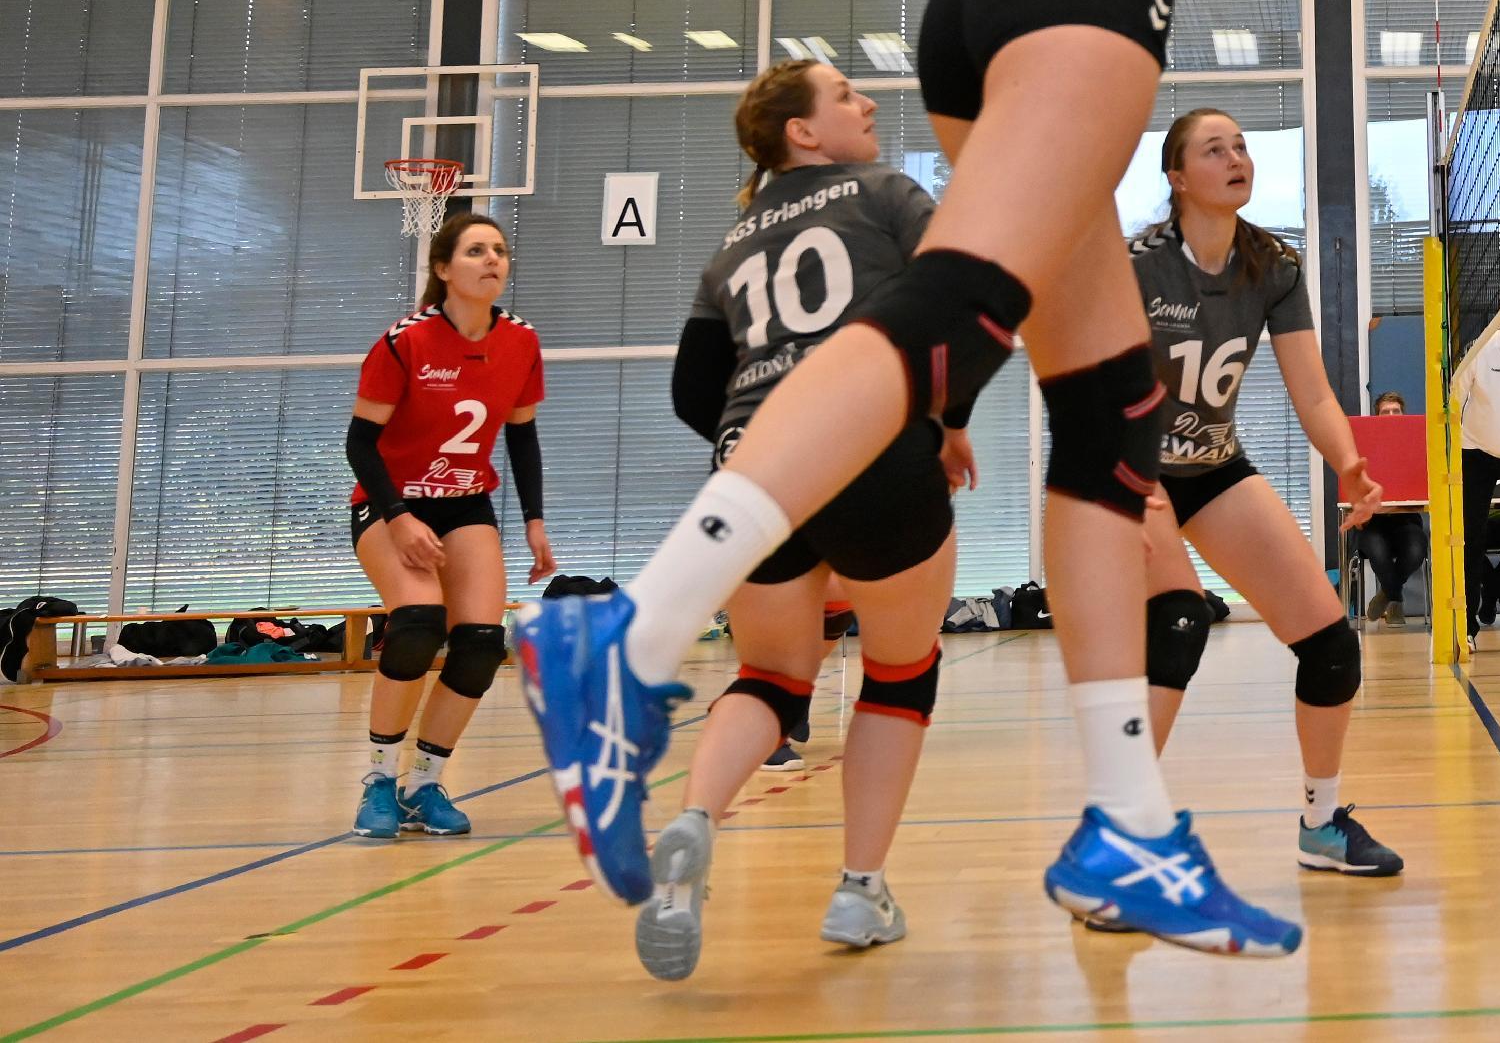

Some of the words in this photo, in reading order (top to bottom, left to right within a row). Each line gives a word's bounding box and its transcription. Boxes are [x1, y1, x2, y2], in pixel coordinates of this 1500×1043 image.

[611, 197, 647, 237] A
[760, 180, 859, 229] Erlangen
[727, 226, 853, 349] 10
[1169, 336, 1248, 408] 16
[438, 399, 488, 455] 2
